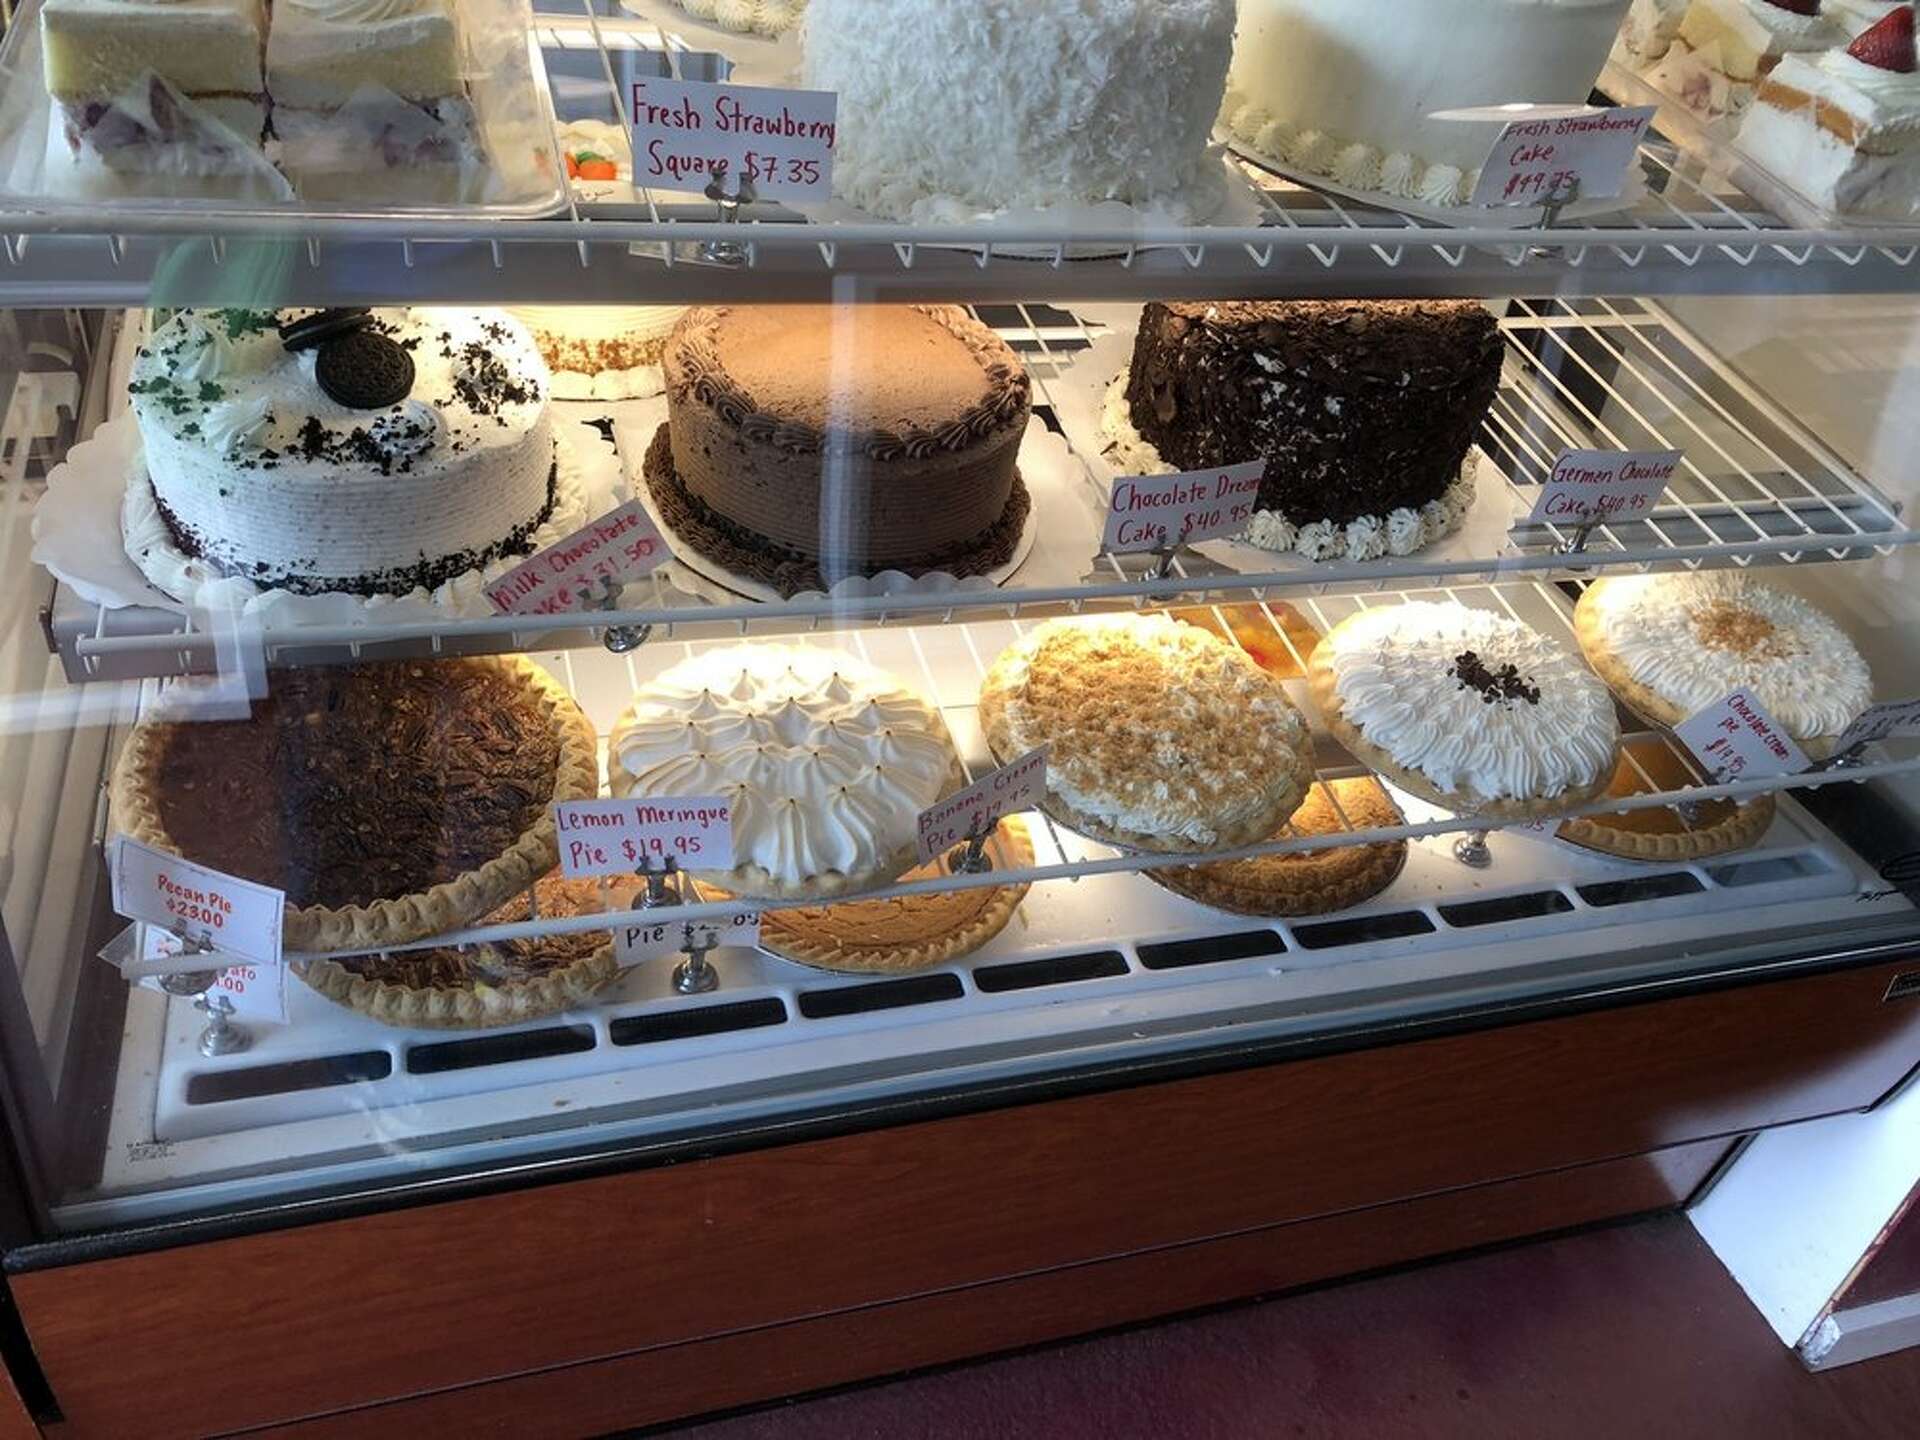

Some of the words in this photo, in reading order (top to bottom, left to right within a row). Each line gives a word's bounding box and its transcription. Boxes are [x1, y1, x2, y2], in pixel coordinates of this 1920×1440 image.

[632, 83, 700, 129] Fresh
[715, 96, 836, 149] Strawberry
[1502, 121, 1550, 141] Fresh
[1555, 116, 1644, 136] Strawberry
[648, 139, 729, 181] Square
[745, 151, 821, 185] $7.35
[1509, 143, 1554, 166] Cake
[1113, 482, 1207, 513] Chocolate
[1545, 493, 1584, 515] Cake
[1118, 519, 1167, 545] Cake
[488, 572, 545, 612] Milk
[548, 513, 639, 573] Chocolate
[919, 792, 984, 834] Banana
[993, 756, 1042, 791] Cream
[557, 807, 625, 832] Lemon
[636, 805, 729, 829] Meringue
[569, 840, 608, 869] Pie
[621, 835, 702, 863] $19.95
[157, 874, 205, 904] Pecan
[208, 890, 232, 913] Pie
[166, 898, 224, 928] $23.00
[626, 926, 664, 948] Pie
